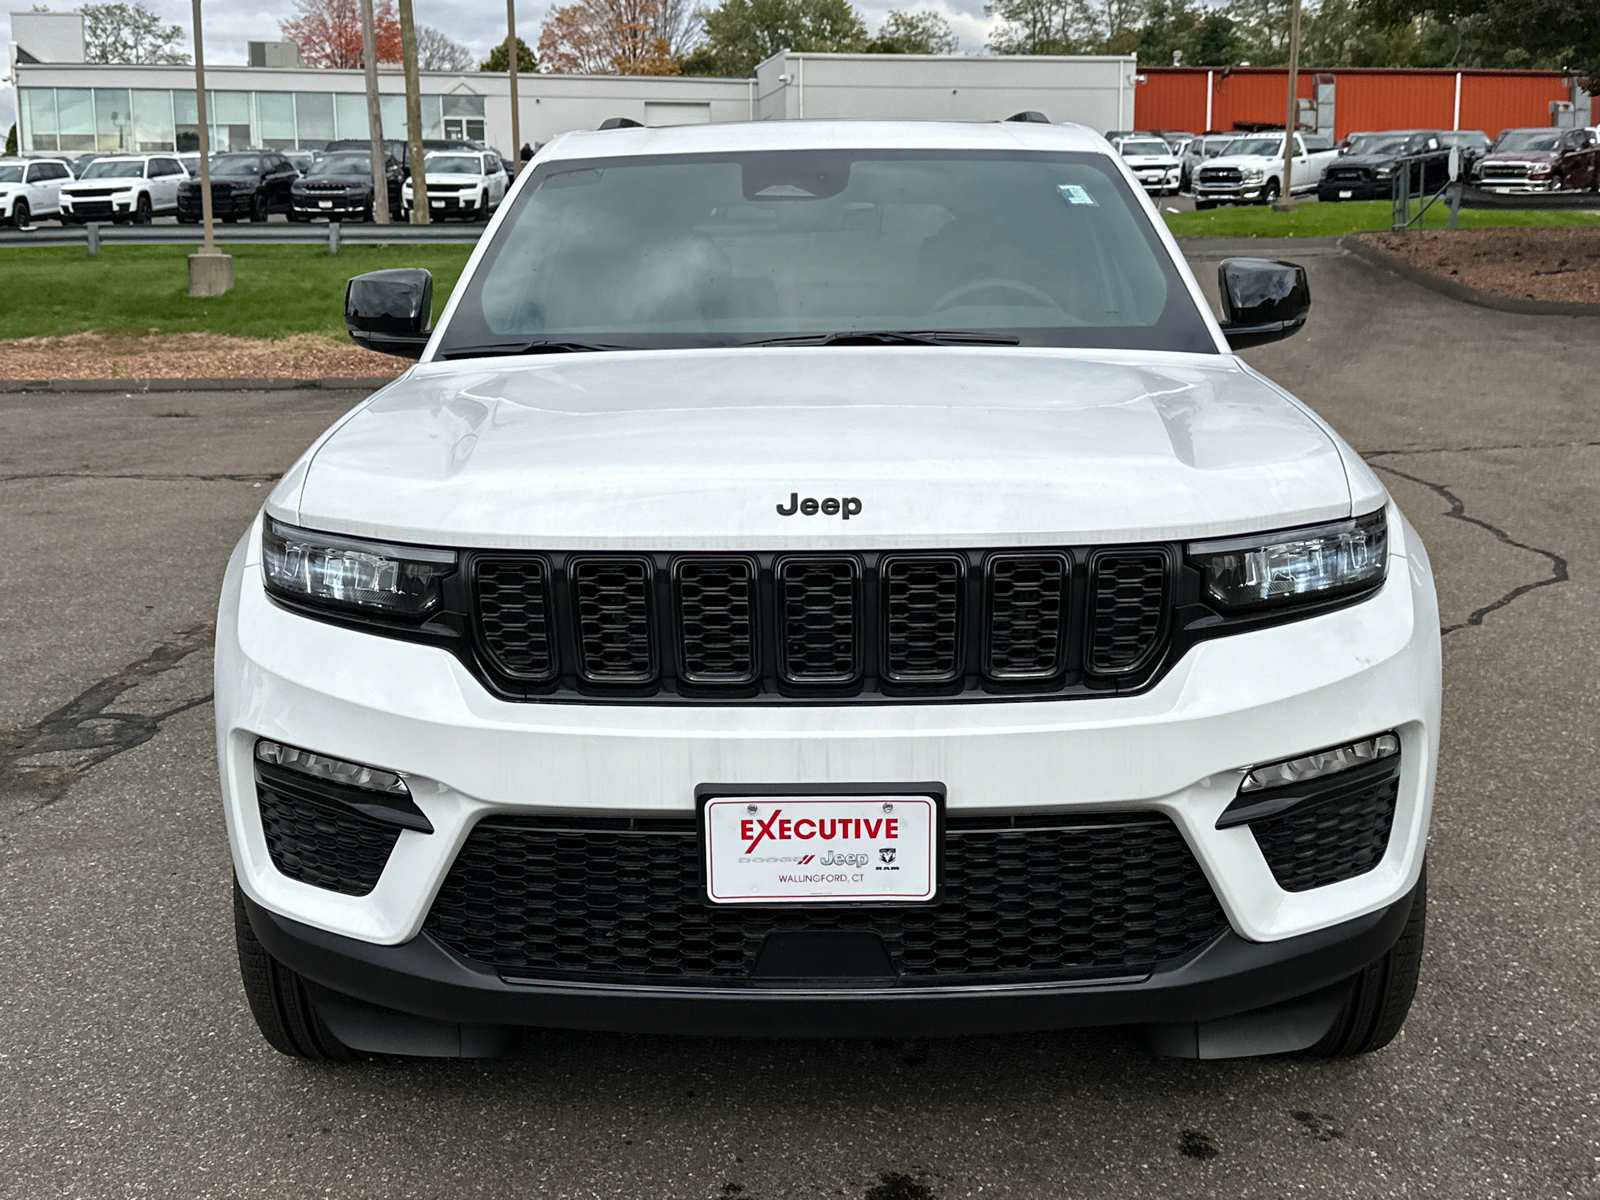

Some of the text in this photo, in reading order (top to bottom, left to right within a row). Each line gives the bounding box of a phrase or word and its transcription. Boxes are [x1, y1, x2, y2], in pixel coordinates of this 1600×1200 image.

[776, 492, 862, 520] Jeep
[741, 809, 898, 854] EXECUTIVE
[820, 850, 869, 868] Jeep
[778, 873, 865, 883] WALLINGFORD, CT
